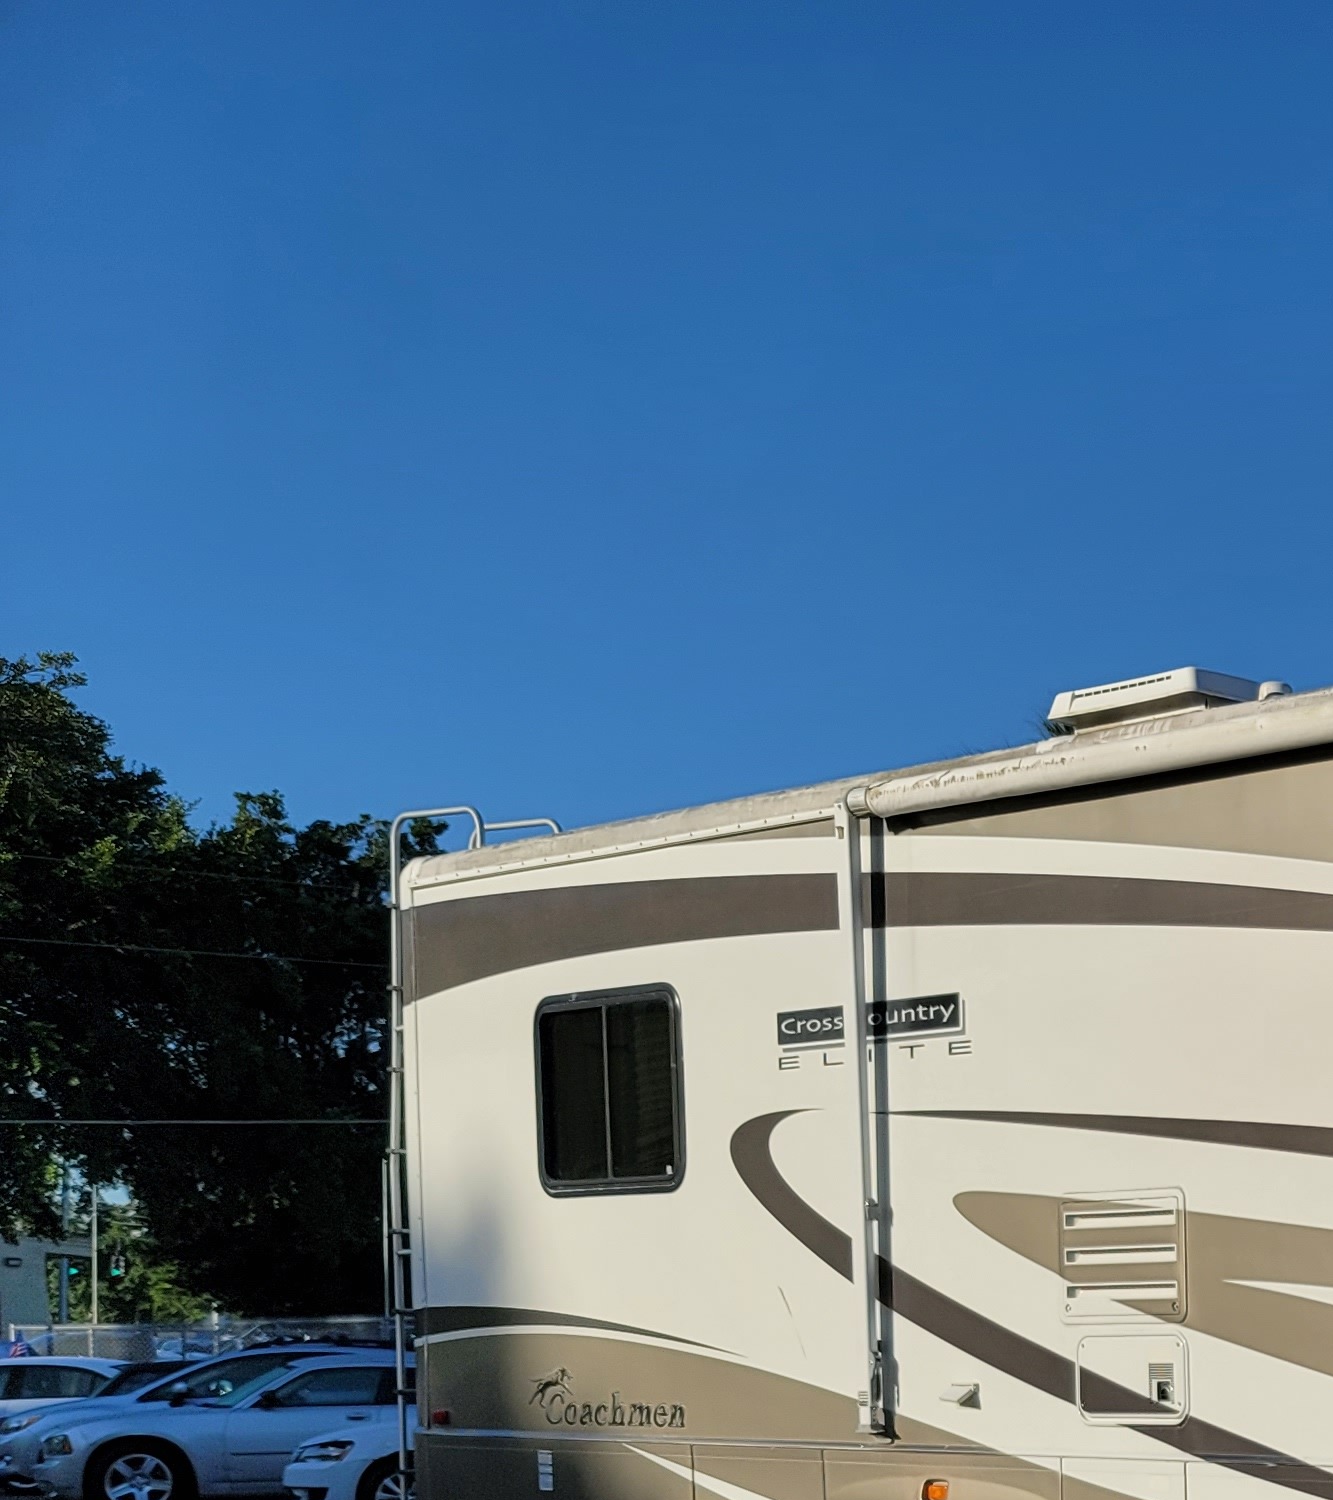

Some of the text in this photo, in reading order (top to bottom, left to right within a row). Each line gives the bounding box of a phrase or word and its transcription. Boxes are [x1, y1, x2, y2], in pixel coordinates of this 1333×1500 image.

[780, 1001, 956, 1035] Cross ountry
[778, 1039, 973, 1071] ELITE
[545, 1390, 687, 1428] Coachmen
